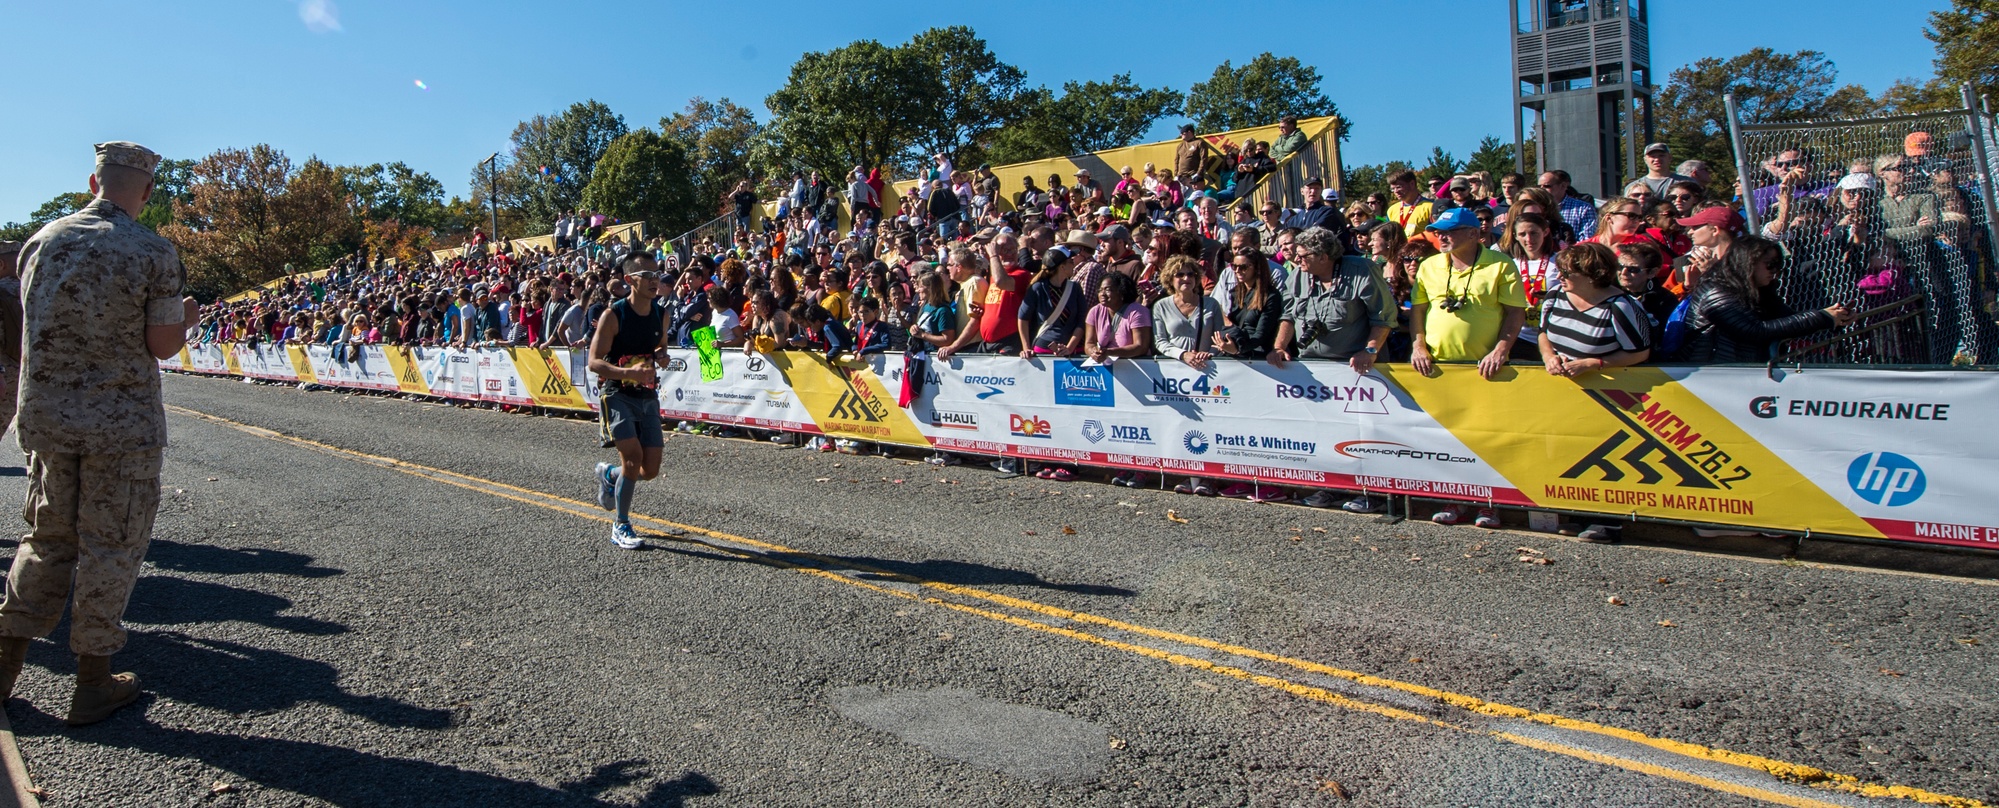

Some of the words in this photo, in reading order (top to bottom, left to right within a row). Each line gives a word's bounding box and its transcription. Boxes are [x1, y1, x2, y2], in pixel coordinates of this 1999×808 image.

[451, 356, 469, 364] GEICO
[925, 372, 942, 385] AA
[964, 376, 1015, 386] BROOKS
[1060, 372, 1107, 391] AQUAFINA
[1153, 378, 1190, 395] NBC
[1192, 374, 1211, 395] 4
[852, 374, 873, 402] MCM
[868, 395, 888, 422] 26.2
[1276, 384, 1374, 402] ROSSLYN
[766, 400, 791, 408] TURBANA
[1788, 400, 1950, 421] ENDURANCE
[932, 412, 976, 424] U-HAUL
[1010, 414, 1051, 436] Dole
[824, 422, 842, 430] MARINE
[842, 424, 860, 432] CORPS
[861, 425, 891, 436] MARATHON
[1111, 425, 1151, 440] MBA
[936, 437, 956, 447] MARINE
[956, 439, 975, 448] CORPS
[976, 441, 1008, 452] MARATHON
[1017, 445, 1091, 460] #RUNWITHTHEMARINES
[1216, 433, 1245, 446] Pratt
[1248, 436, 1258, 447] &
[1261, 436, 1316, 454] Whitney
[1637, 402, 1702, 452] MCM
[1686, 440, 1752, 490] 26.2
[1107, 454, 1134, 464] MARINE
[1136, 456, 1160, 467] CORPS
[1162, 458, 1204, 471] MARATHON
[1241, 451, 1278, 460] Technologies
[1279, 455, 1308, 463] Company
[1345, 446, 1476, 464] MARATHONFOTO.COM
[1224, 464, 1325, 483] #RUNWITHTHEMARINES
[1857, 452, 1918, 506] hp
[1355, 475, 1393, 488] MARINE
[1394, 478, 1430, 492] CORPS
[1432, 482, 1492, 498] MARATHON
[1545, 484, 1600, 502] MARINE
[1604, 489, 1657, 507] CORPS
[1662, 494, 1753, 515] MARATHON
[1915, 522, 1980, 541] MARINE
